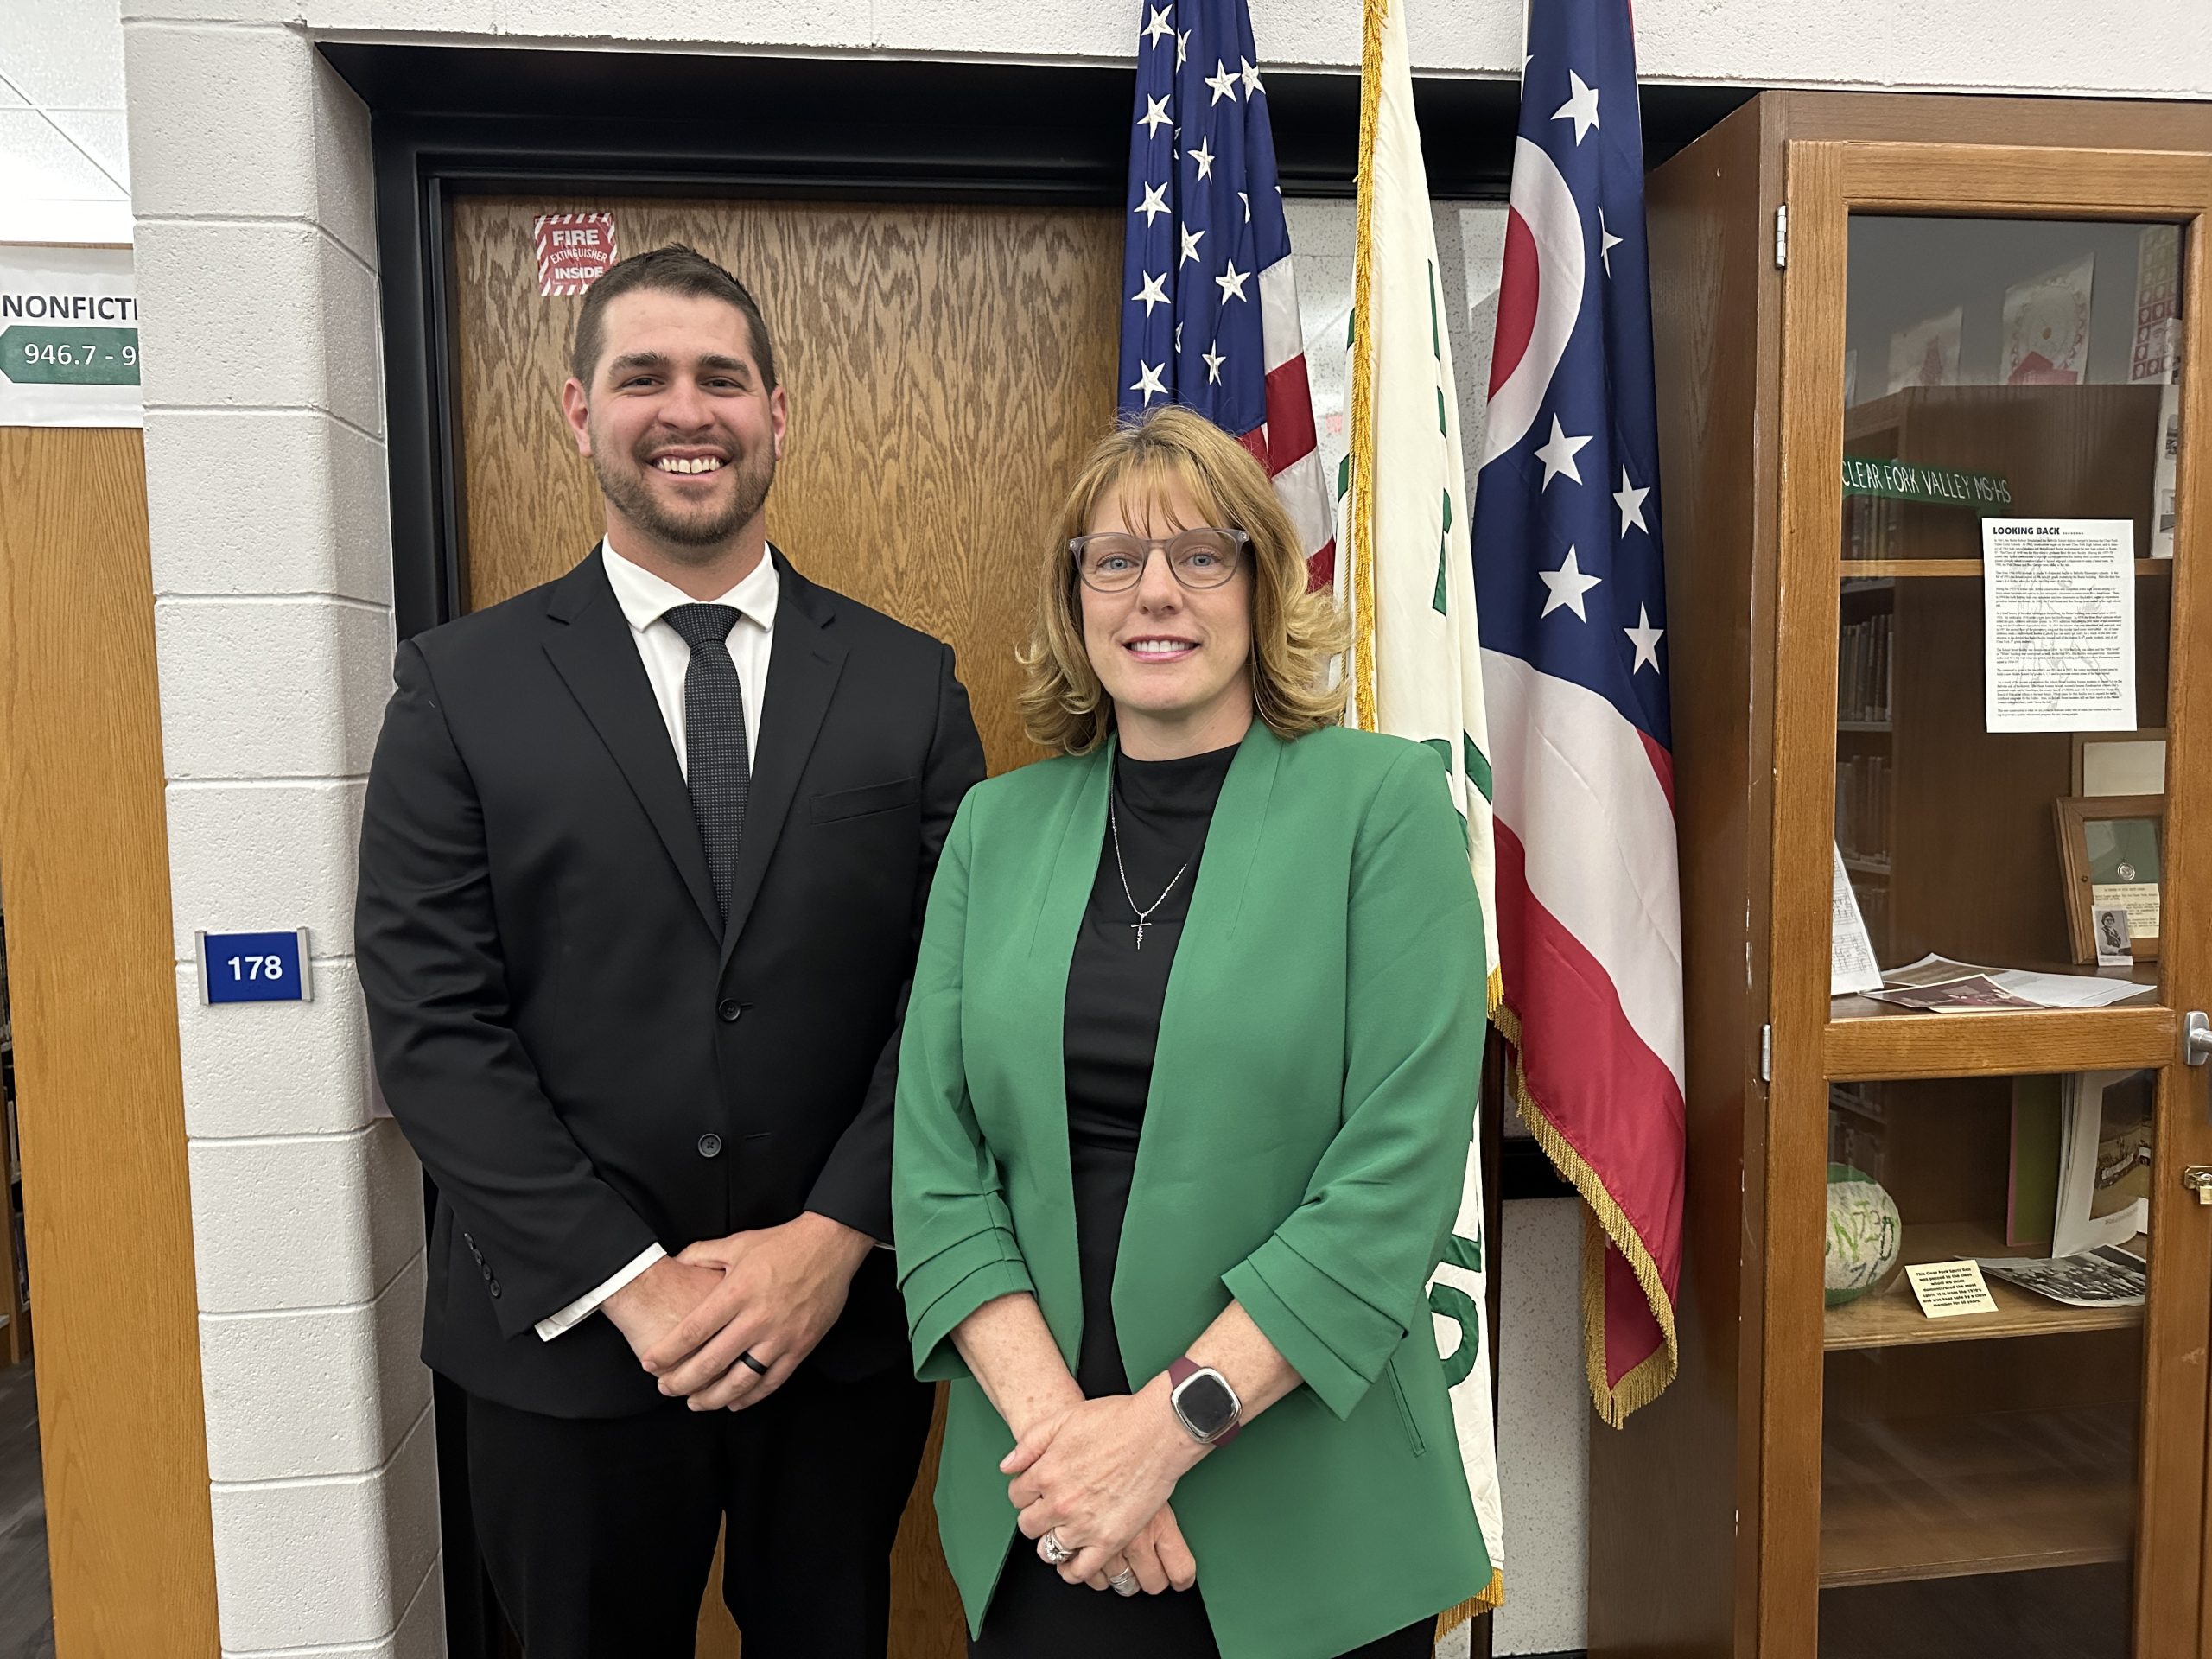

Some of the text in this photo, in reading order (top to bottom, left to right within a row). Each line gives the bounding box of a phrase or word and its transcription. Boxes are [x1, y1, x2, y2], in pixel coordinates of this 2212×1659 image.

[552, 229, 600, 246] FIRE
[550, 248, 607, 264] EXTINGUISHER
[555, 266, 604, 280] INSIDE
[24, 344, 97, 365] 946.7
[122, 346, 137, 366] 9
[1842, 461, 2012, 504] CLEAR FORK VALLEY MS-HS
[228, 955, 283, 981] 178
